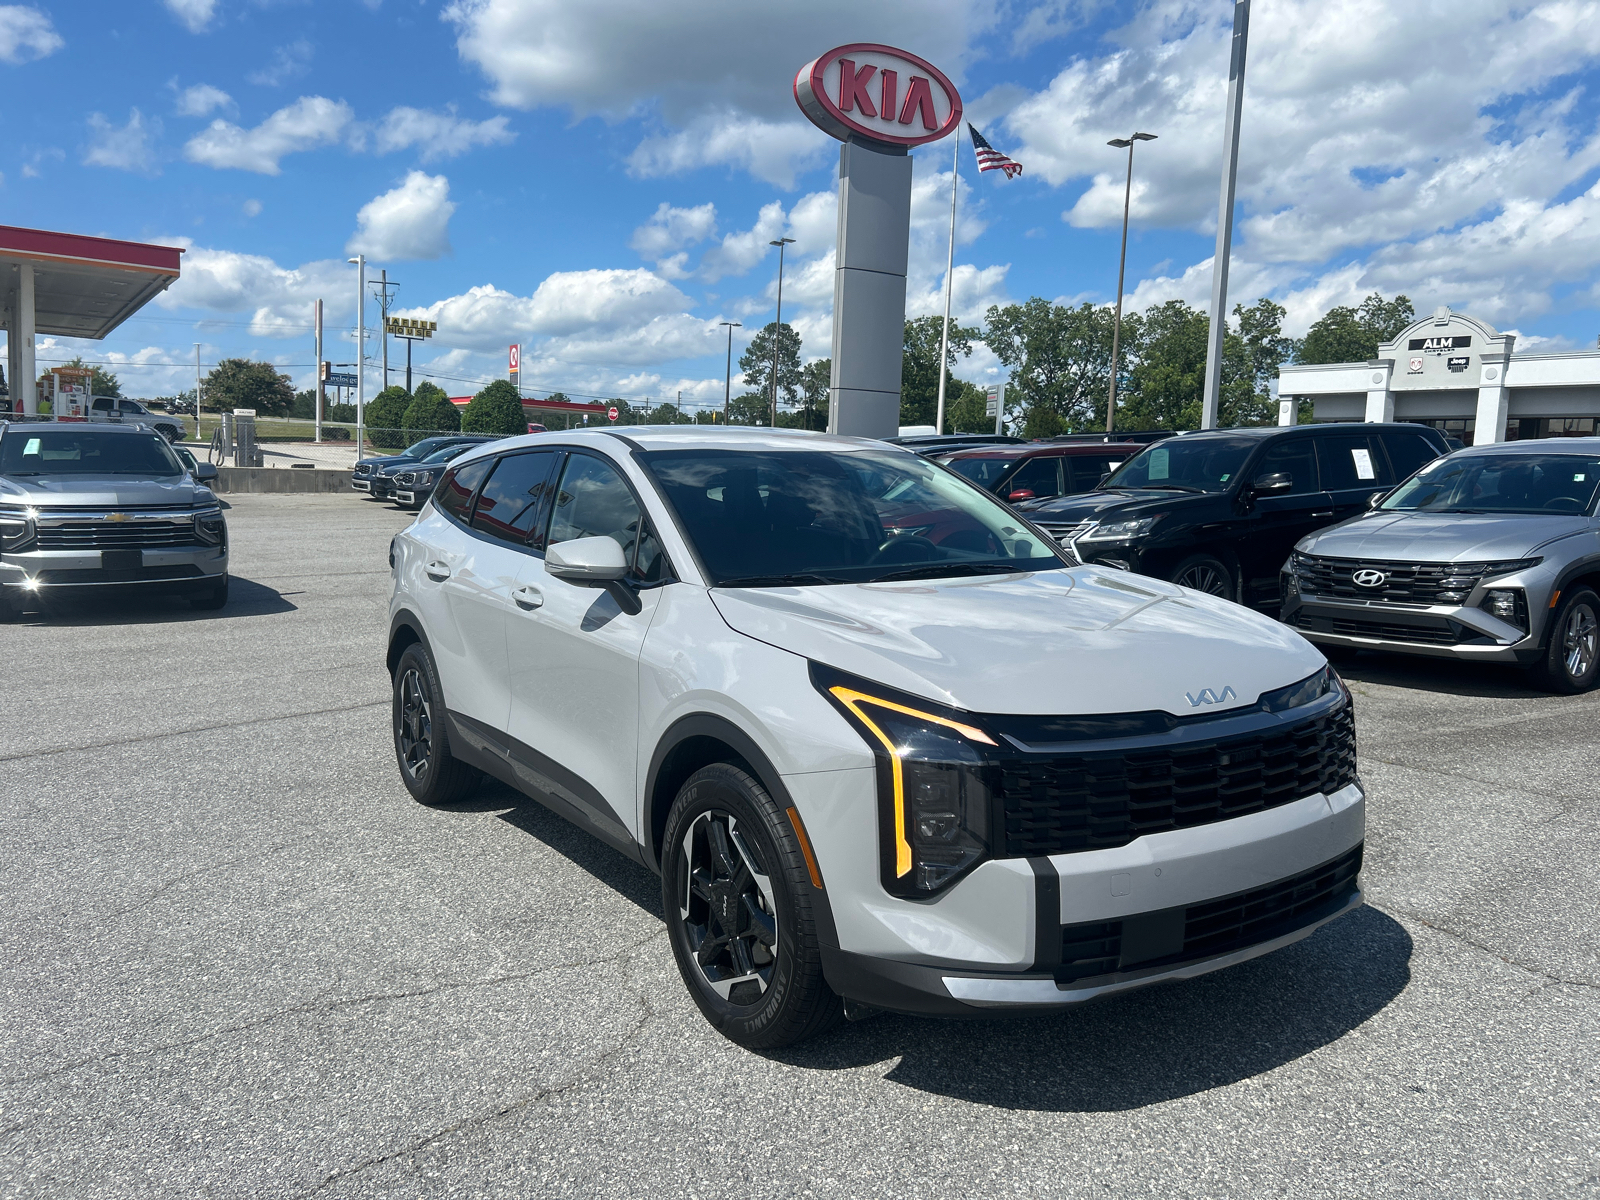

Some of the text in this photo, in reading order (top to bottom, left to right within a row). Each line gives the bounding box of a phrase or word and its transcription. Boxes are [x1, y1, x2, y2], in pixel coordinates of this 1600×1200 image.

[839, 58, 938, 130] KIA
[388, 326, 431, 337] HOUSE
[1423, 338, 1453, 349] ALM
[664, 787, 698, 852] GOODYEAR
[743, 970, 787, 1034] ASSURANCE
